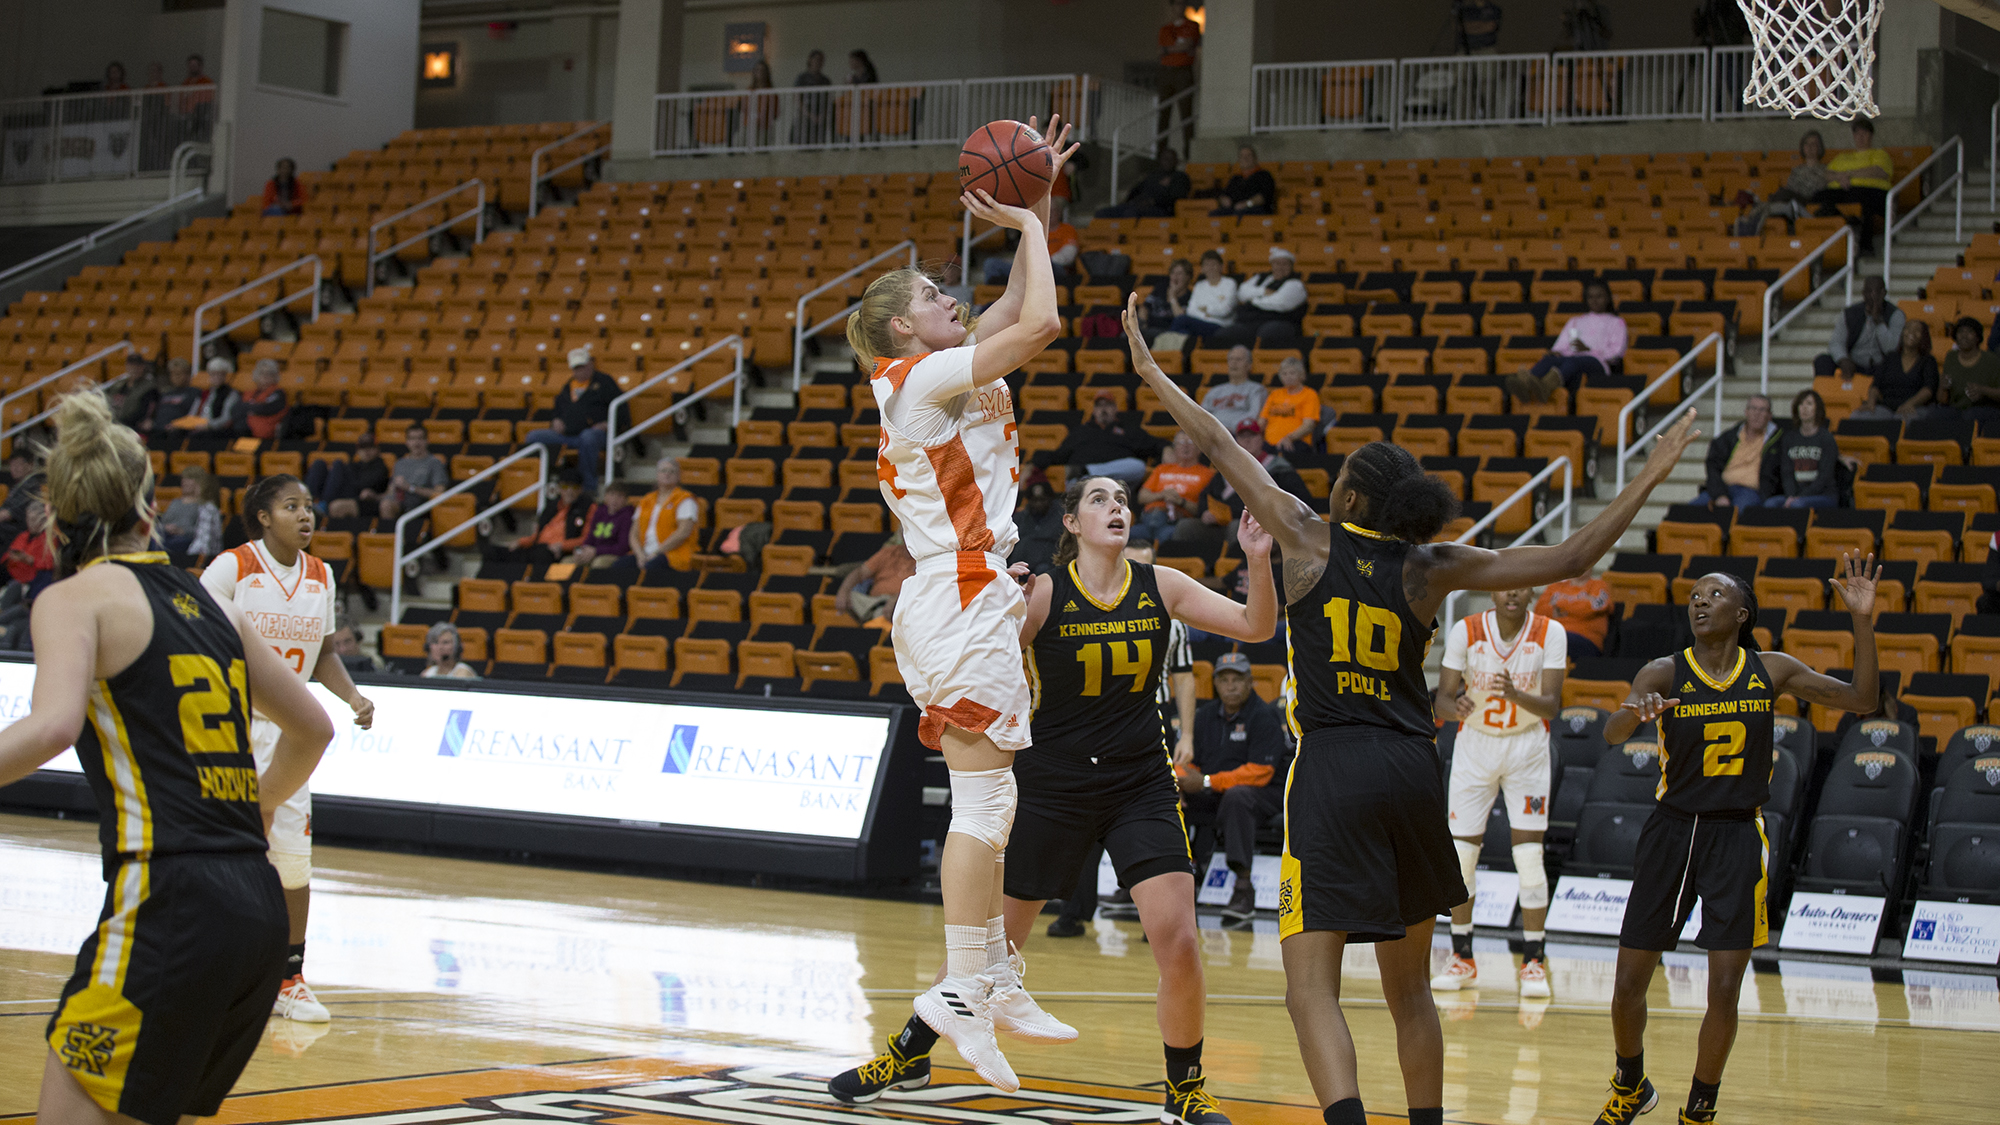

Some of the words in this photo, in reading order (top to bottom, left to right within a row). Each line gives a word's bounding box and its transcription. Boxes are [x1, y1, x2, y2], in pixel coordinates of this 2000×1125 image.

[1059, 620, 1126, 637] KENNESAW
[1127, 617, 1161, 633] STATE
[1323, 597, 1402, 672] 10
[1076, 639, 1153, 697] 14
[168, 653, 253, 754] 21
[1484, 695, 1518, 729] 21
[1673, 701, 1738, 718] KENNESAW
[1739, 699, 1771, 713] STATE
[467, 728, 631, 765] RENASANT
[1703, 720, 1747, 777] 2
[694, 745, 873, 783] RENASANT
[563, 772, 619, 793] BANK
[799, 789, 861, 812] BANK
[1790, 903, 1879, 923] Auto-Owners
[1808, 921, 1857, 931] INSURANCE
